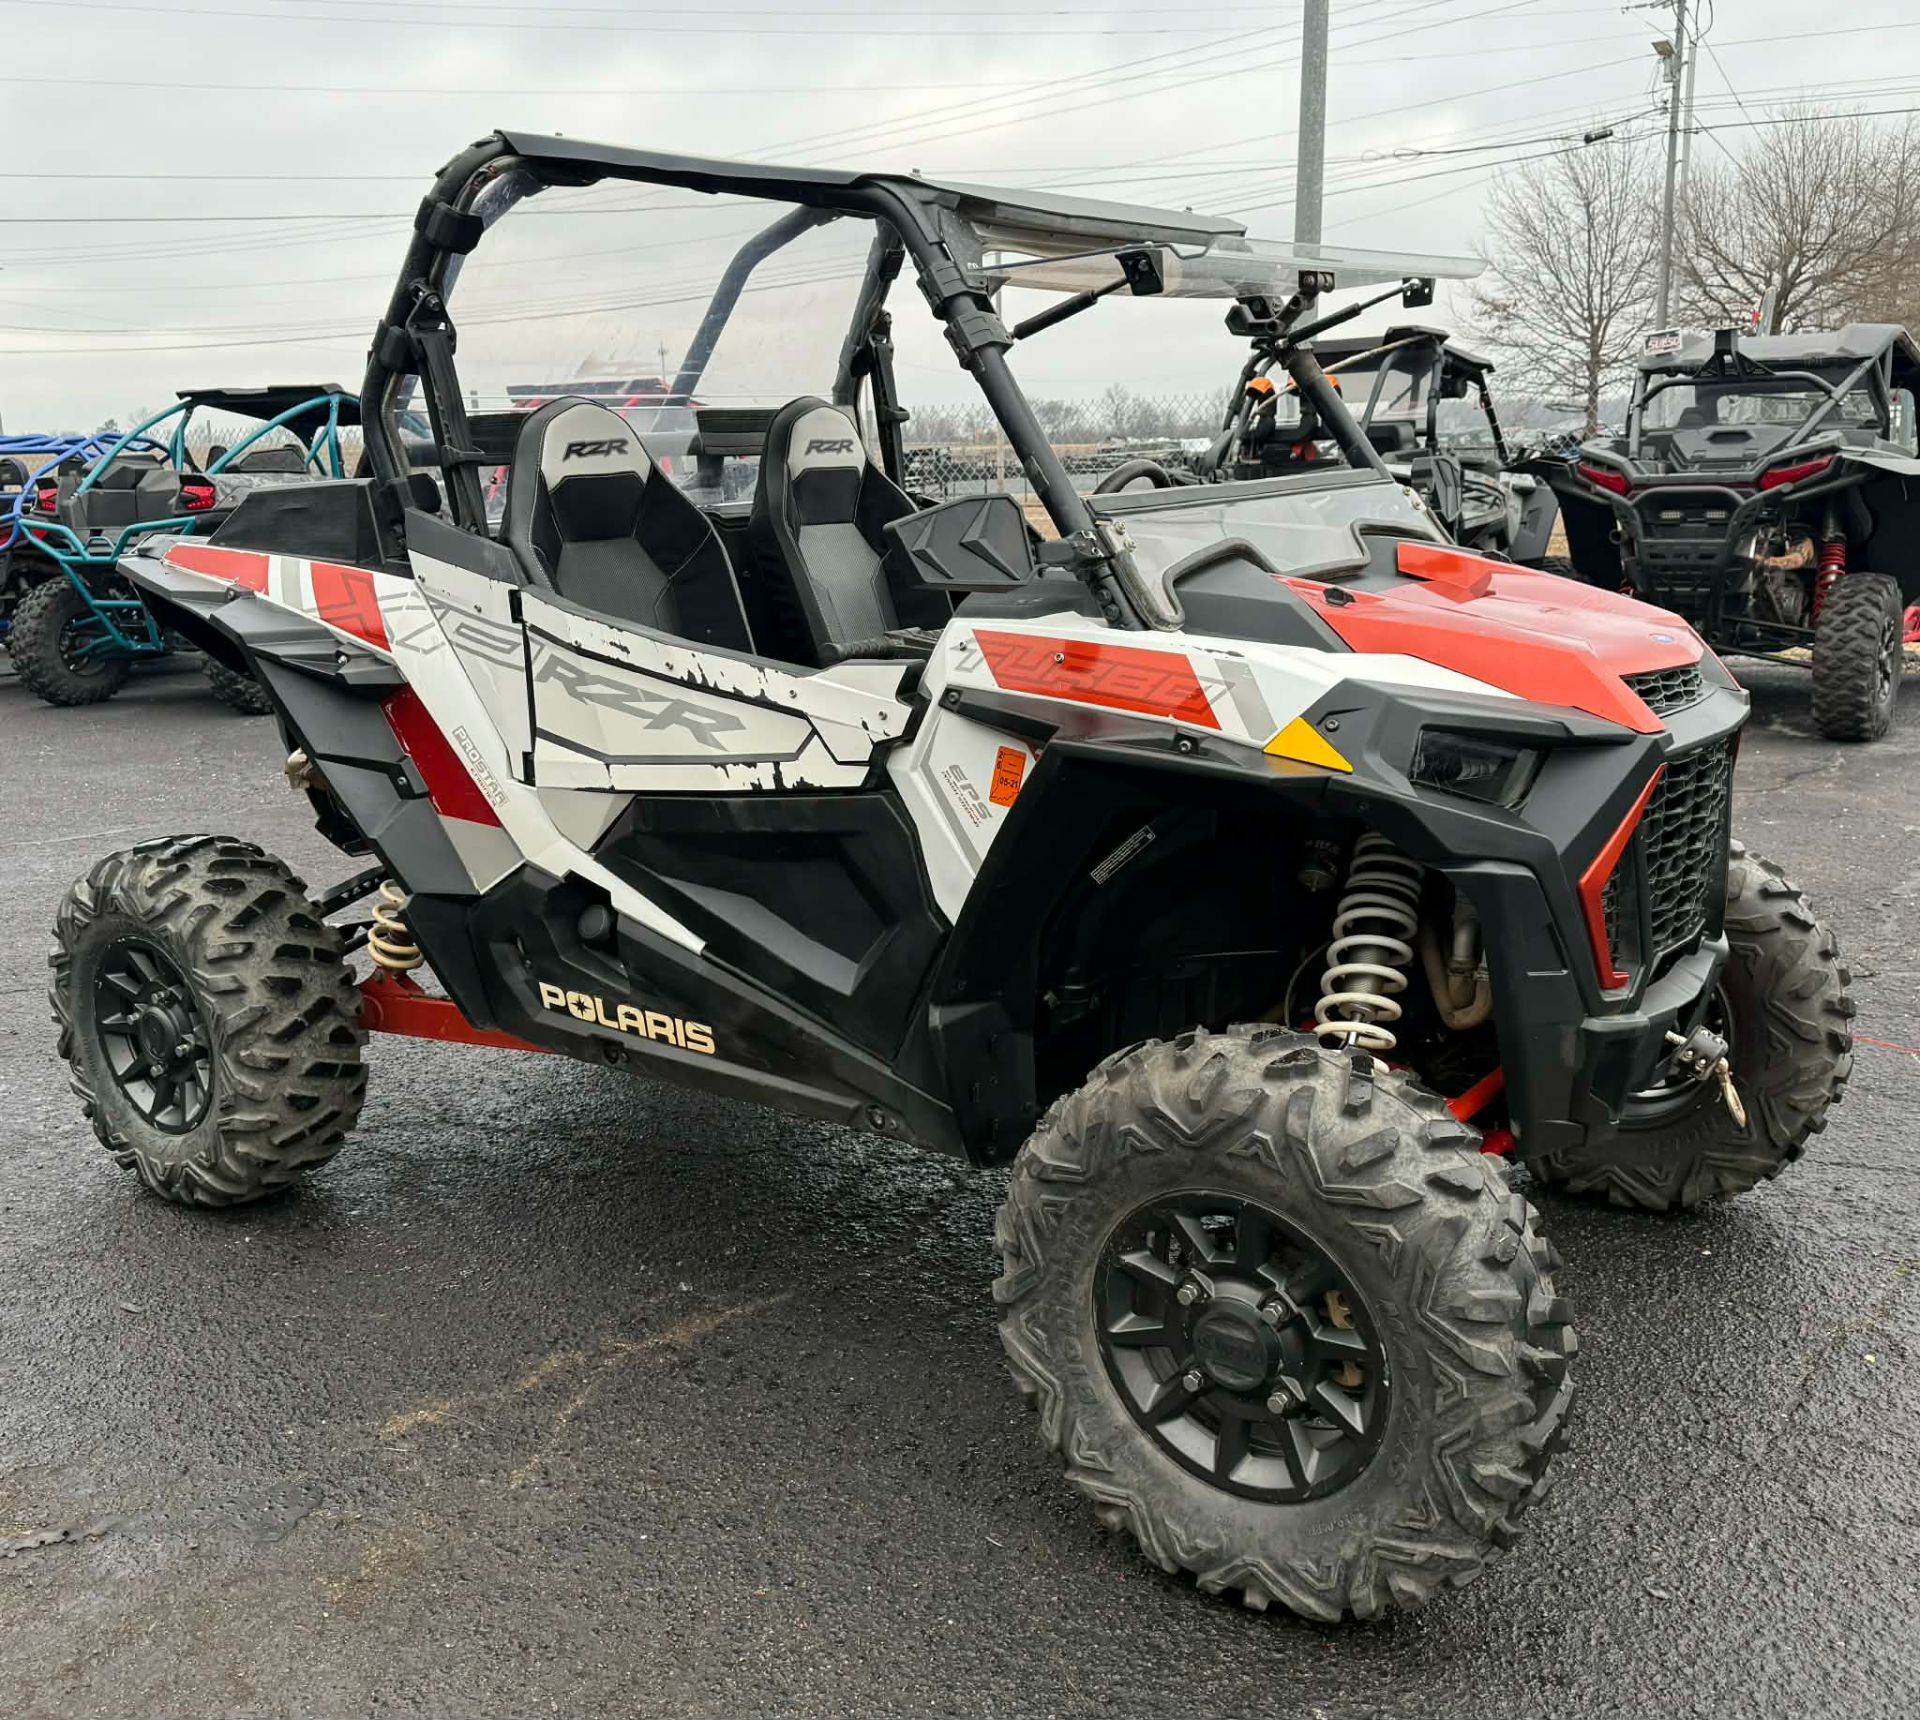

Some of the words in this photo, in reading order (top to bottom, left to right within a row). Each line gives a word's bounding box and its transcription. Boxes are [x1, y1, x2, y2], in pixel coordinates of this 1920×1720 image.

[563, 439, 629, 462] RZR
[806, 438, 855, 455] RZR
[535, 654, 746, 750] RZR
[948, 636, 1235, 715] TURBO
[452, 725, 509, 807] PROSTAR
[949, 765, 992, 820] EPS
[539, 982, 715, 1055] POLARIS
